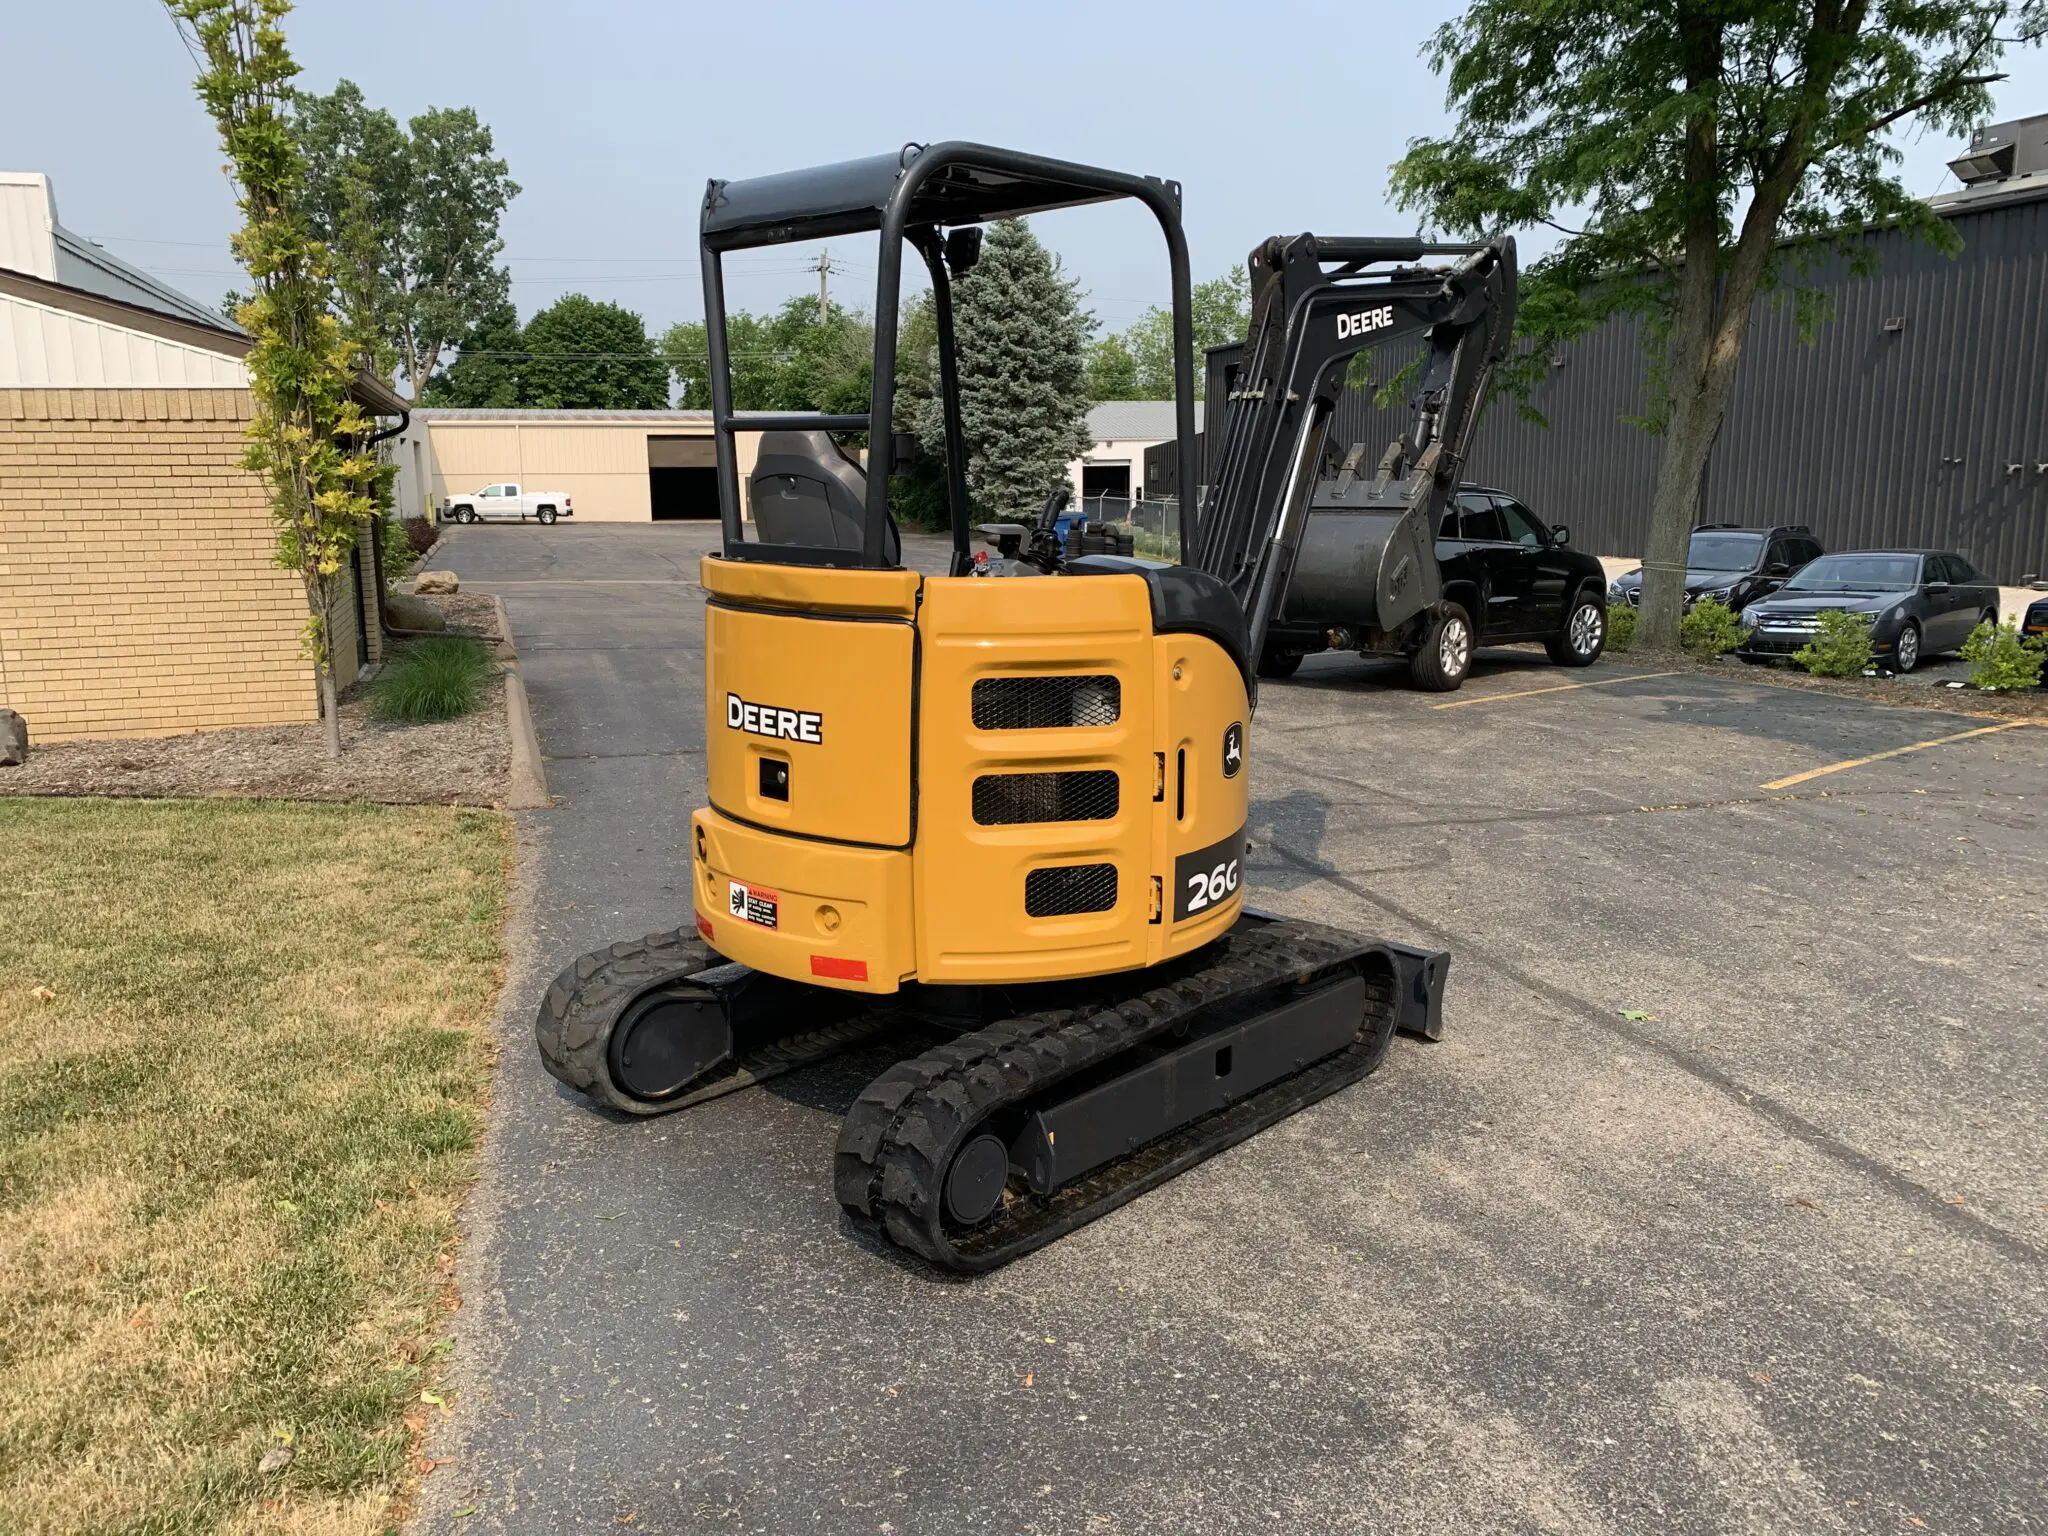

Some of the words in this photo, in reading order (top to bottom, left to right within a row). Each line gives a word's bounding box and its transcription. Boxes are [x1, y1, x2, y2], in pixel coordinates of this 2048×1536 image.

[1336, 305, 1394, 340] DEERE
[727, 693, 821, 744] DEERE
[753, 890, 777, 901] WARNING
[1188, 859, 1237, 911] 26G
[748, 897, 758, 905] STAY
[759, 901, 773, 909] CLEAR
